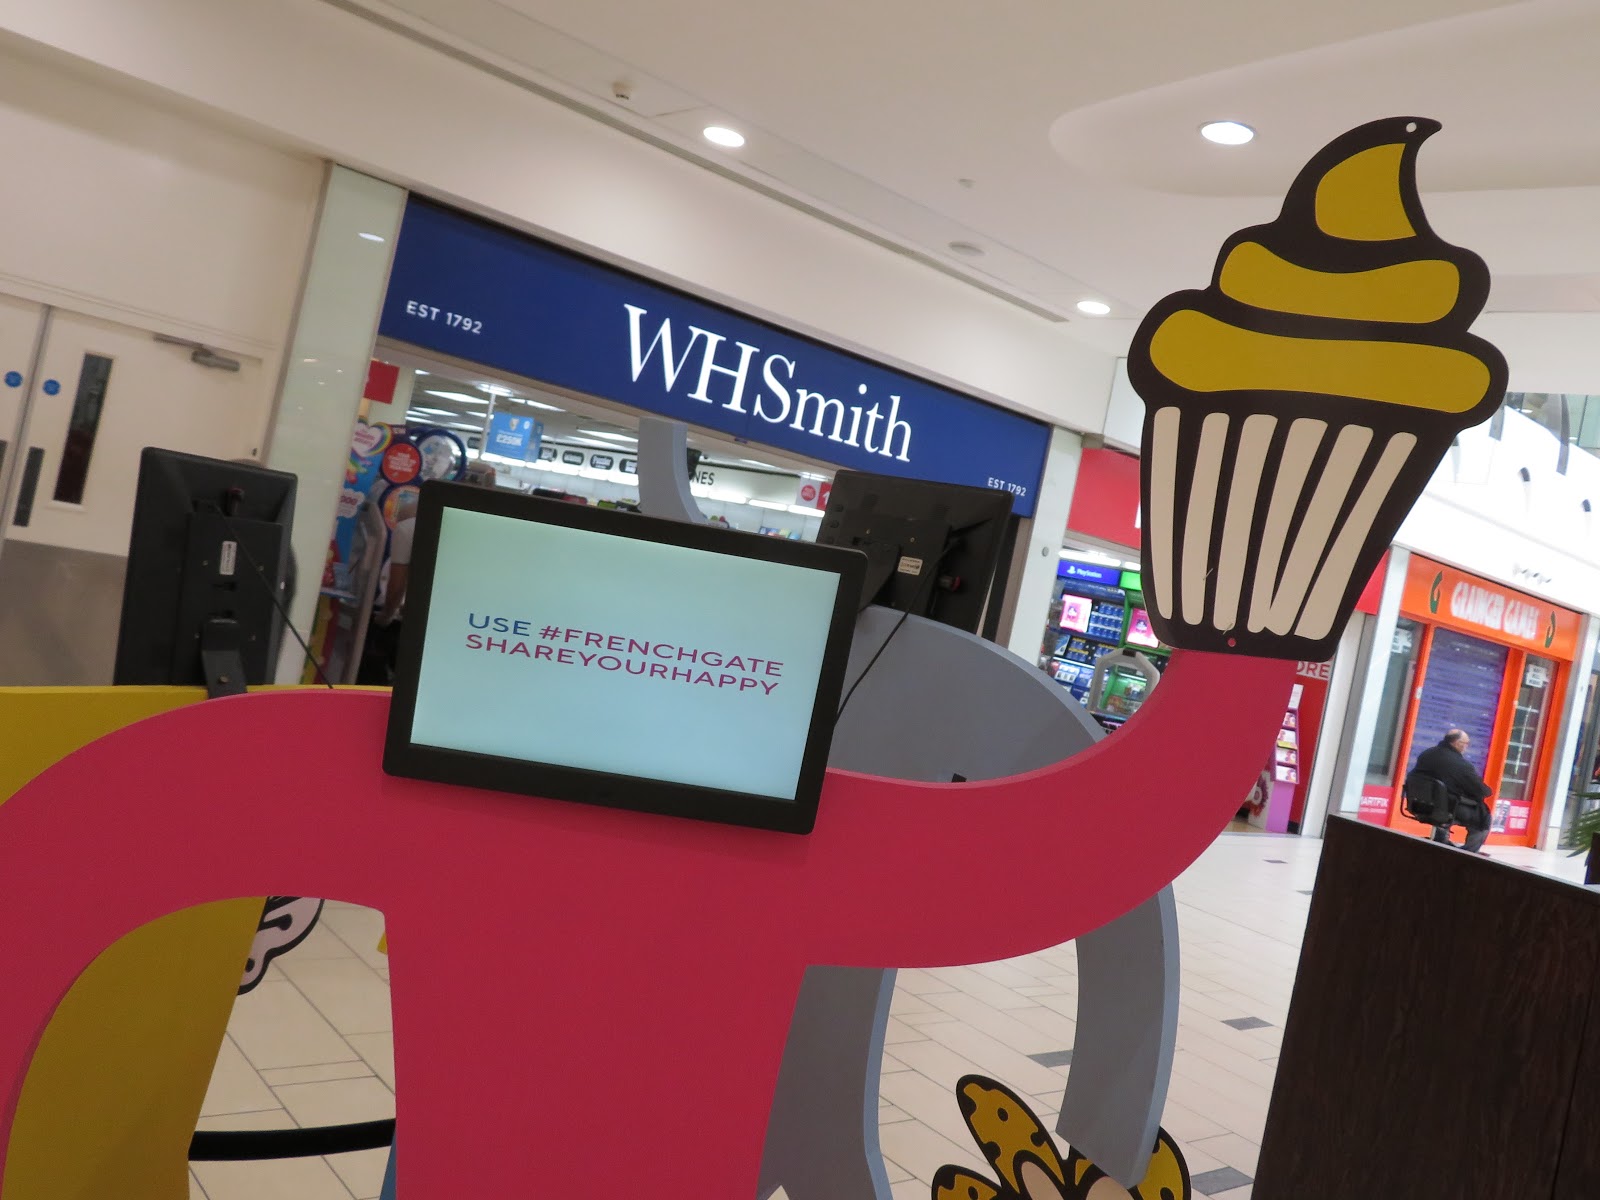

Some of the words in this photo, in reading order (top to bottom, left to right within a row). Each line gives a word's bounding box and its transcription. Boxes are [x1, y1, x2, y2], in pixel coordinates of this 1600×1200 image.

[406, 300, 440, 321] EST
[446, 312, 483, 334] 1792
[623, 303, 912, 463] WHSmith
[987, 477, 1006, 490] EST
[1007, 483, 1027, 497] 1792
[465, 634, 780, 696] SHAREYOURHAPPY
[468, 612, 532, 637] USE
[538, 625, 785, 678] #FRENCHGATE
[1360, 795, 1389, 809] ARTFIX
